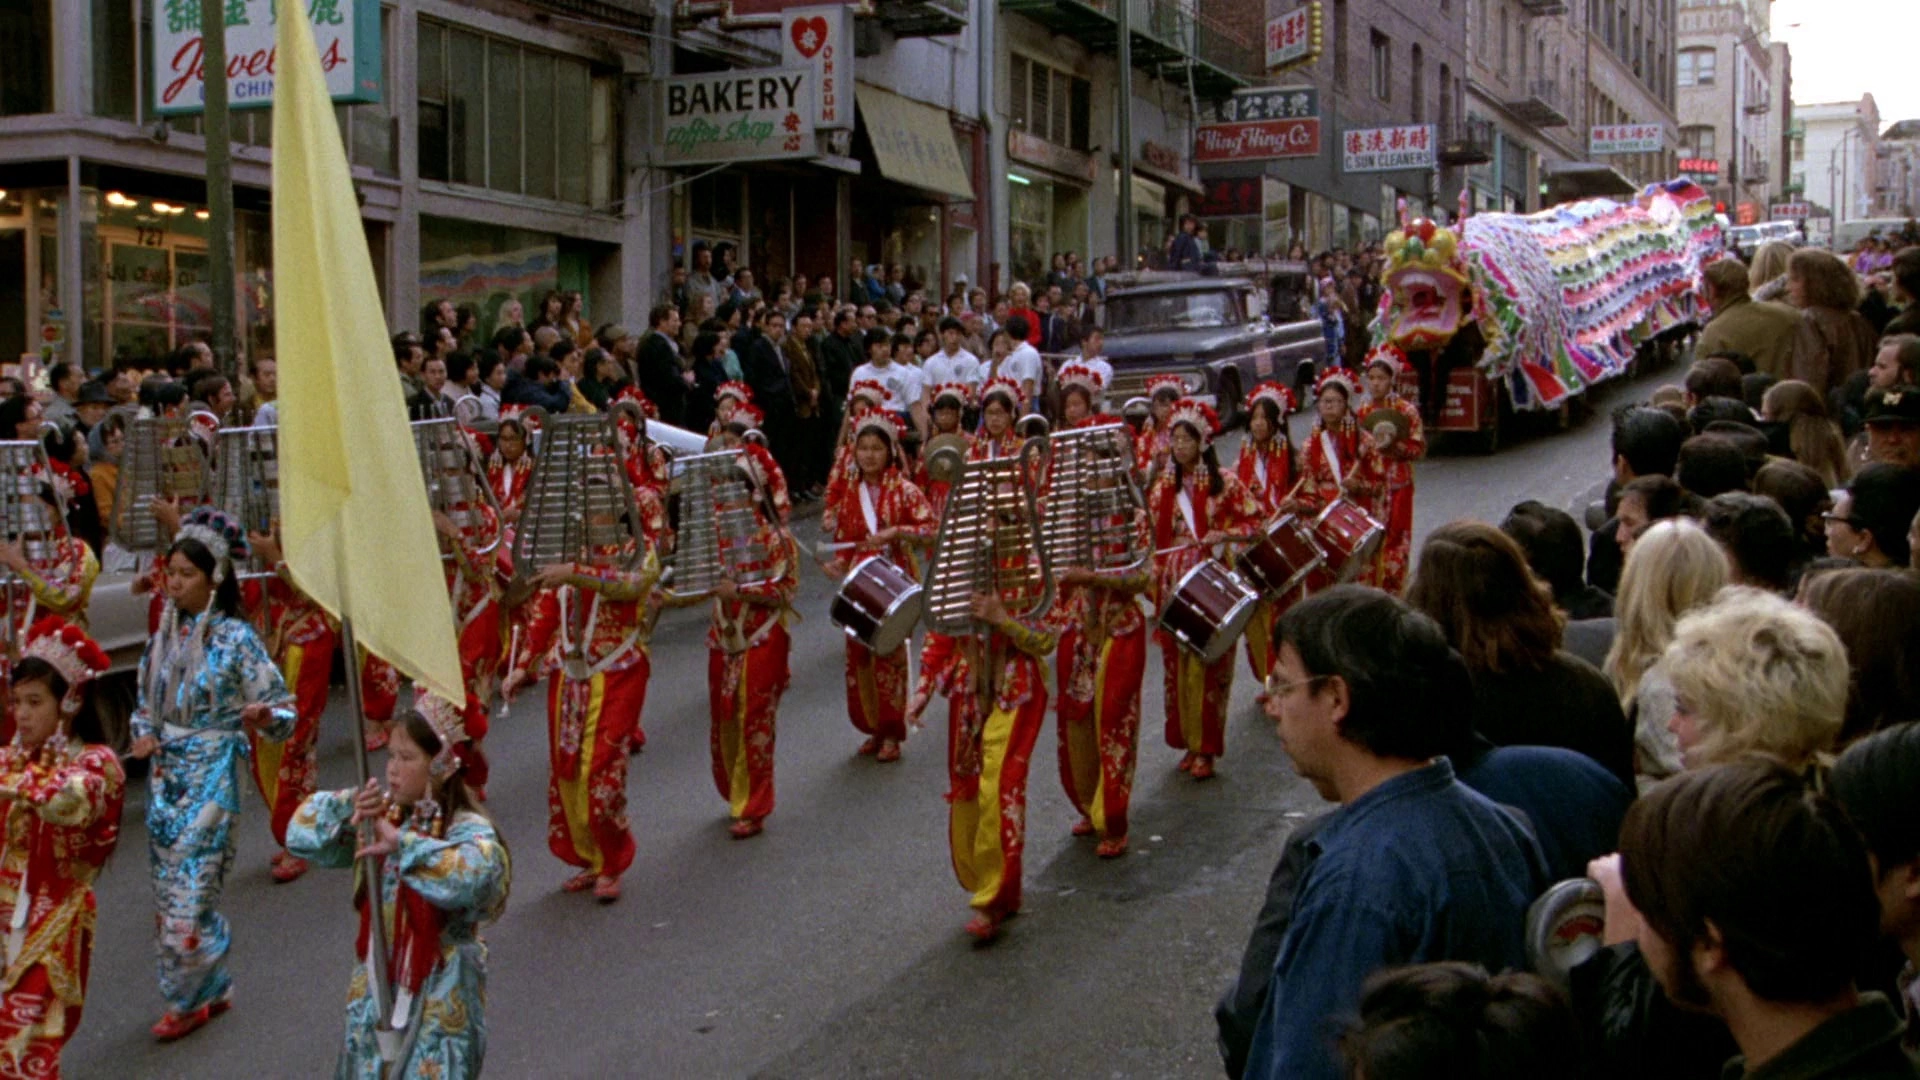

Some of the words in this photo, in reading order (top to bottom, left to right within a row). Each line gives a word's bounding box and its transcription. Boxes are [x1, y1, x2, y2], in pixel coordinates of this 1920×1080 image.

[668, 75, 802, 116] BAKERY
[667, 117, 721, 153] coffee
[725, 112, 774, 147] shop
[1378, 150, 1430, 167] CLEANERS
[136, 225, 163, 247] 727
